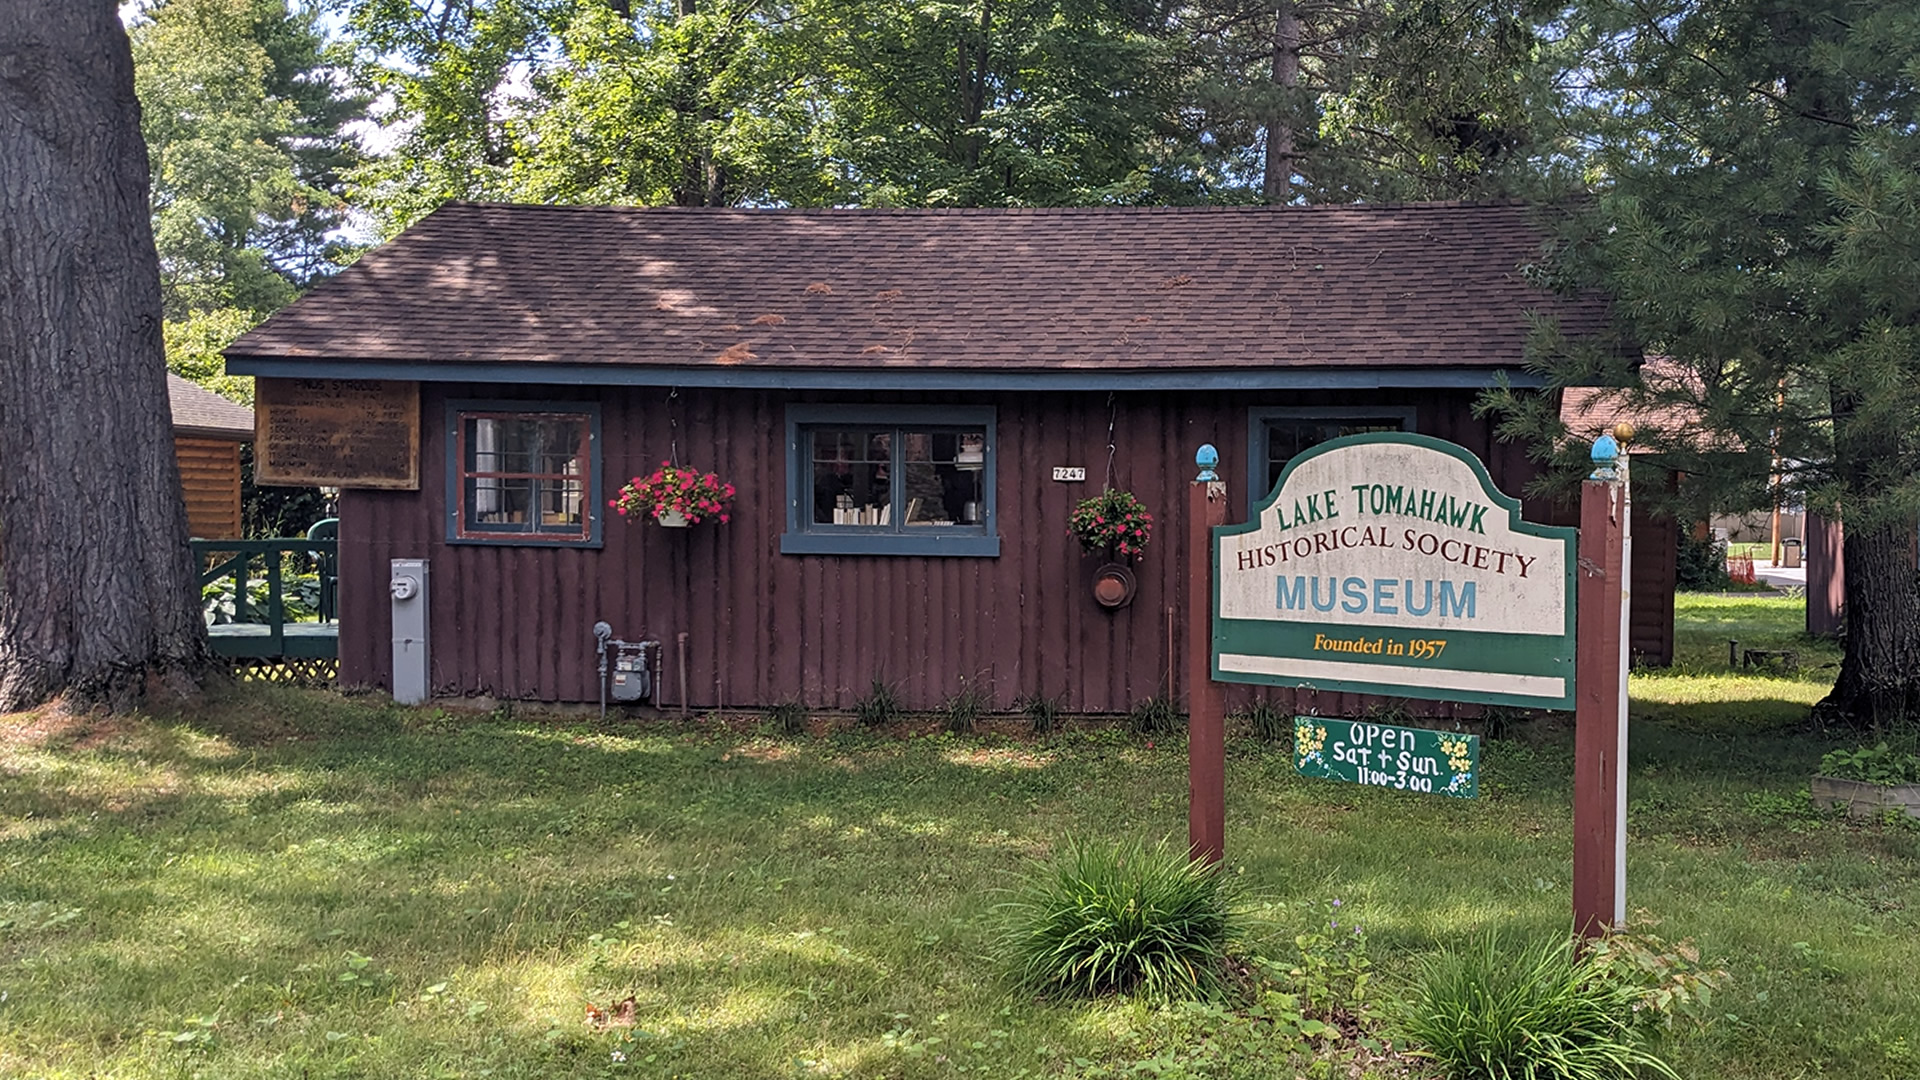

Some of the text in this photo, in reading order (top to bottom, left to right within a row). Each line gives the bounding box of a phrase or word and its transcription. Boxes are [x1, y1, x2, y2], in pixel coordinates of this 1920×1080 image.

[1054, 468, 1084, 479] 7247
[1275, 484, 1489, 535] LAKE TOMAHAWK
[1237, 525, 1537, 578] HISTORICAL SOCIETY
[1276, 575, 1476, 619] MUSEUM
[1313, 633, 1447, 660] Founded in 1957
